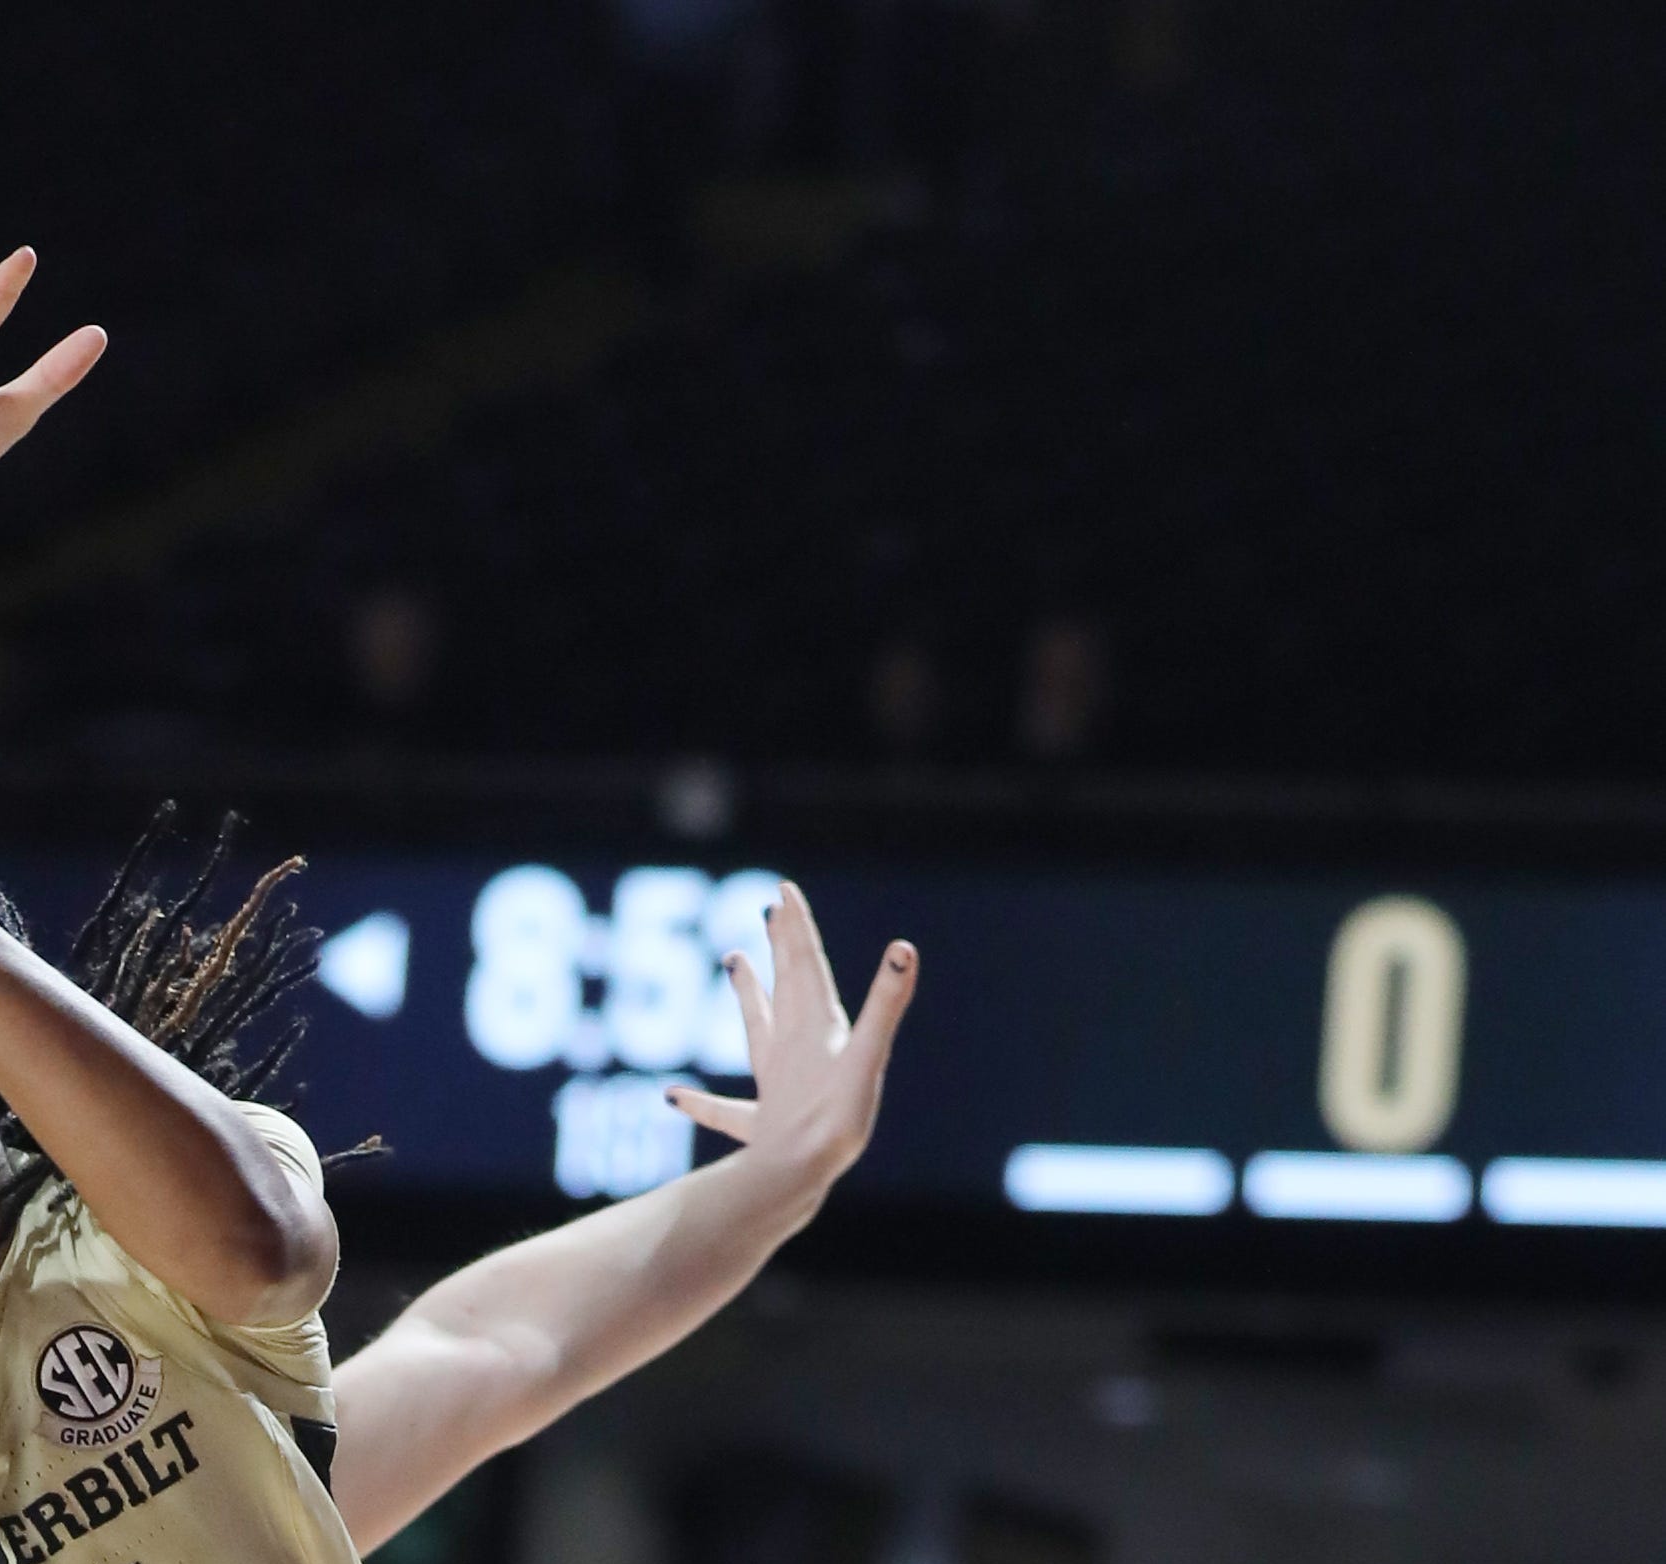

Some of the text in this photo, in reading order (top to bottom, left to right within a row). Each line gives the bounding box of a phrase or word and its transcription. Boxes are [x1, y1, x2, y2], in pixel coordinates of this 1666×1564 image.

[1318, 895, 1466, 1154] 0
[40, 1331, 129, 1418] SEC
[60, 1384, 157, 1446] GRADUATE
